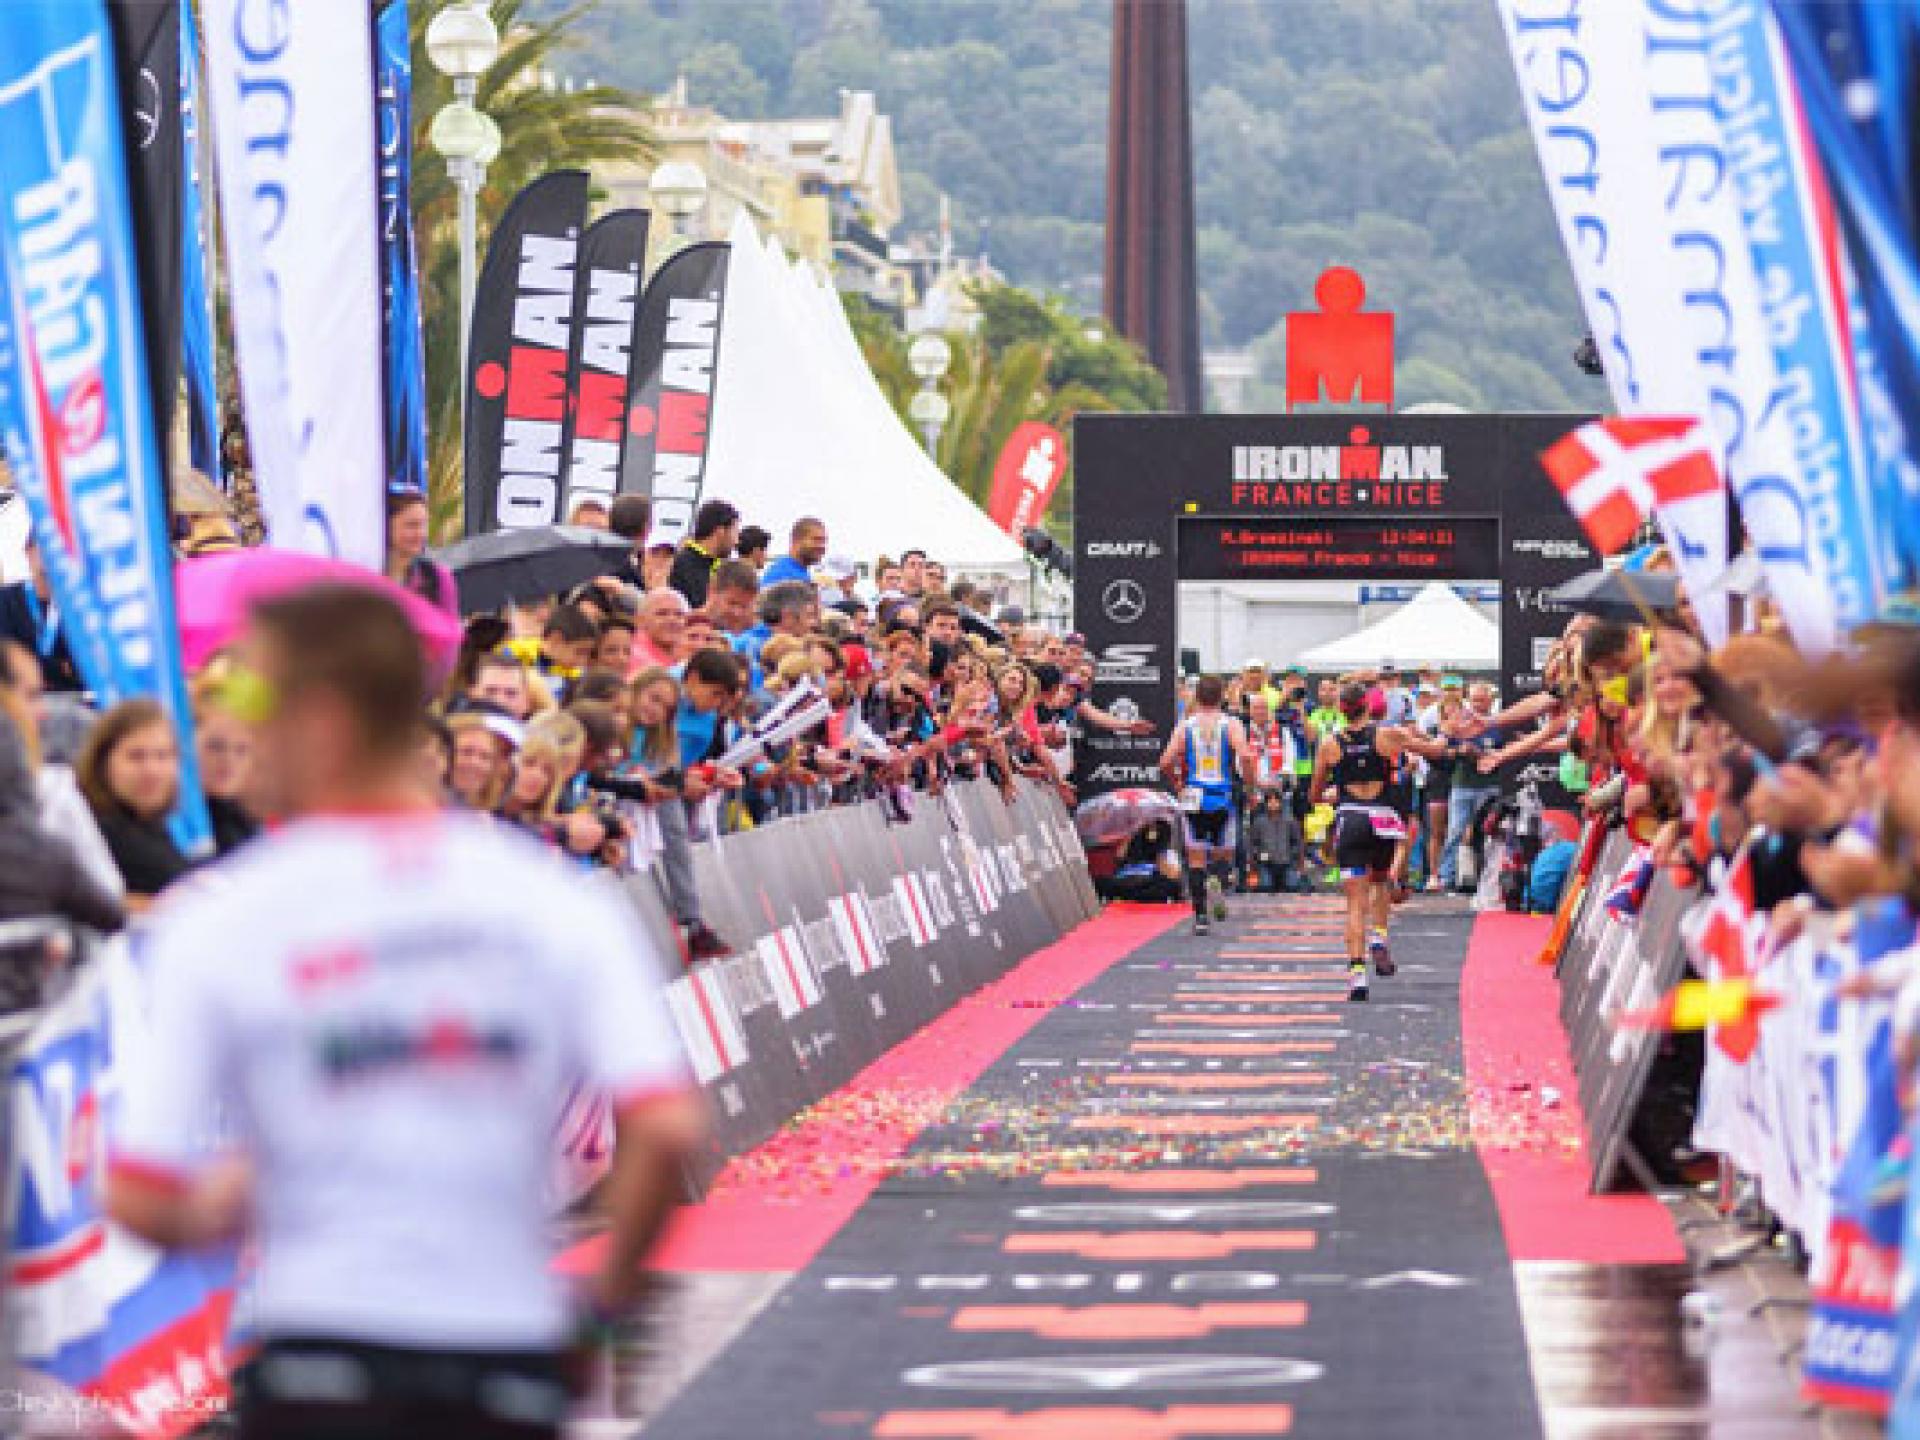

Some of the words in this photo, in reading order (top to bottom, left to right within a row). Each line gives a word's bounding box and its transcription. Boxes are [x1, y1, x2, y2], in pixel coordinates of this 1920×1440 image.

[496, 229, 577, 527] ONMAN
[646, 296, 718, 546] ONMAN
[1231, 434, 1448, 481] IRONMAN
[1231, 483, 1348, 505] FRANCE
[1372, 483, 1443, 505] NICE
[1087, 542, 1146, 558] CRAFT
